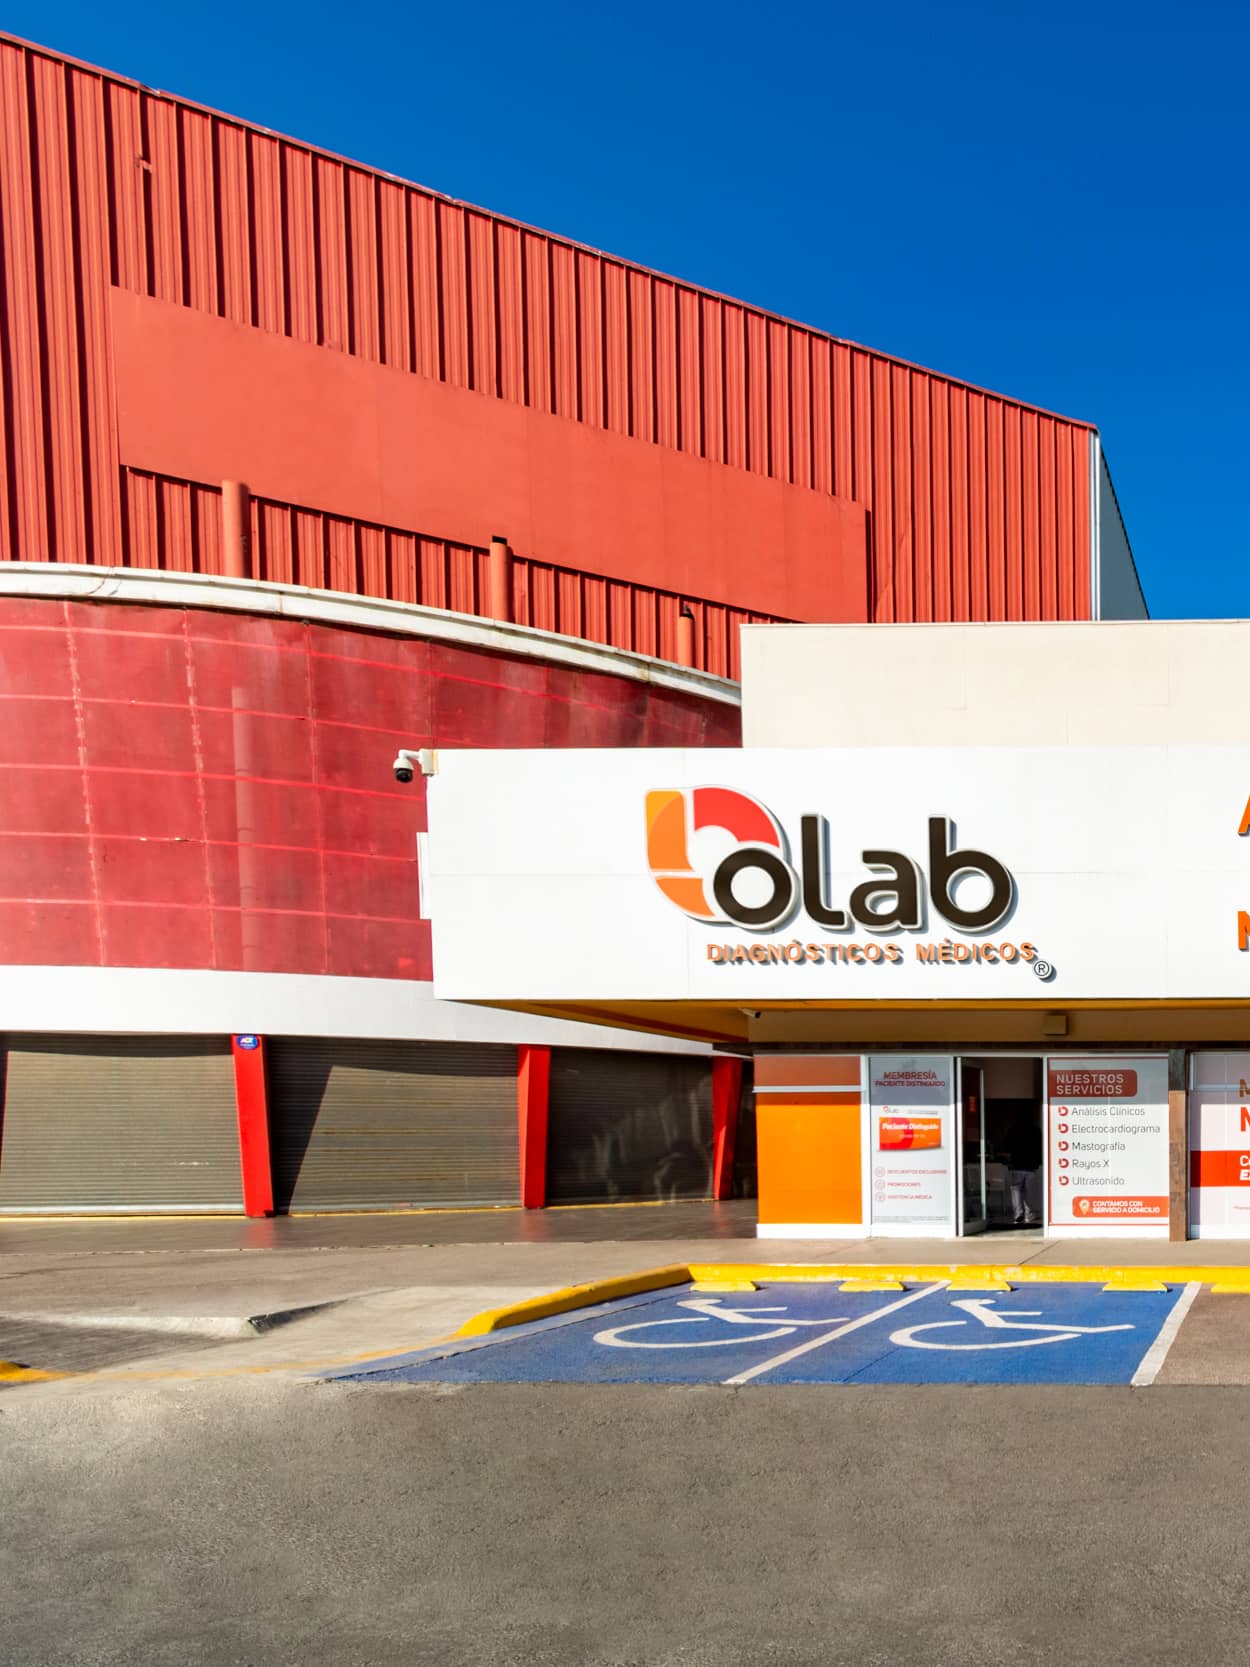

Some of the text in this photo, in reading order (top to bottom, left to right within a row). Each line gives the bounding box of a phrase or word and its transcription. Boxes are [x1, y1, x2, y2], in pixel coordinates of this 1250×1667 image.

[706, 938, 1037, 964] DIAGNÓSTICOS MÉDICOS
[883, 1070, 937, 1080] MEMBRESÍA
[1056, 1074, 1124, 1084] NUESTROS
[1056, 1085, 1123, 1095] SERVICIOS
[1071, 1106, 1145, 1116] Análisis Clínicos
[1071, 1124, 1160, 1134] Electrocardiograma
[1071, 1141, 1126, 1153] Mastografía
[1072, 1159, 1110, 1170] Rayos X
[1072, 1175, 1125, 1186] Ultrasonido
